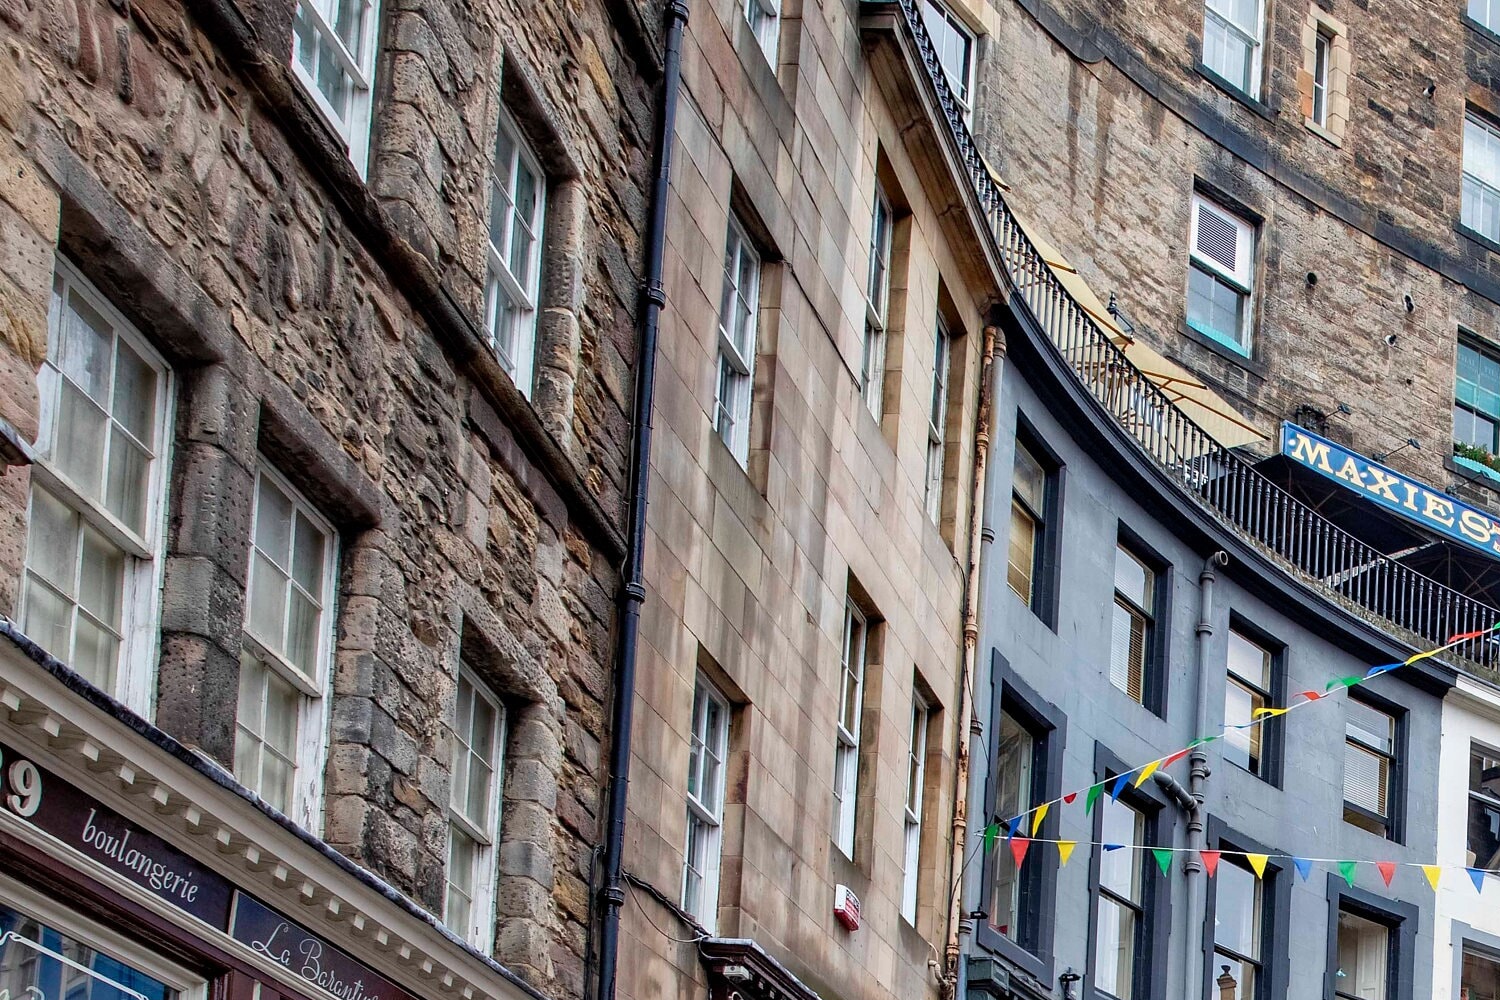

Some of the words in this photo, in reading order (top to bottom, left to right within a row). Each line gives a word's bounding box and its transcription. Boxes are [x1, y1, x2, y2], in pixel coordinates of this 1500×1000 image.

[1291, 433, 1493, 543] MAXIES
[0, 745, 42, 818] 9
[82, 807, 199, 903] boulangerie
[251, 922, 291, 967] La
